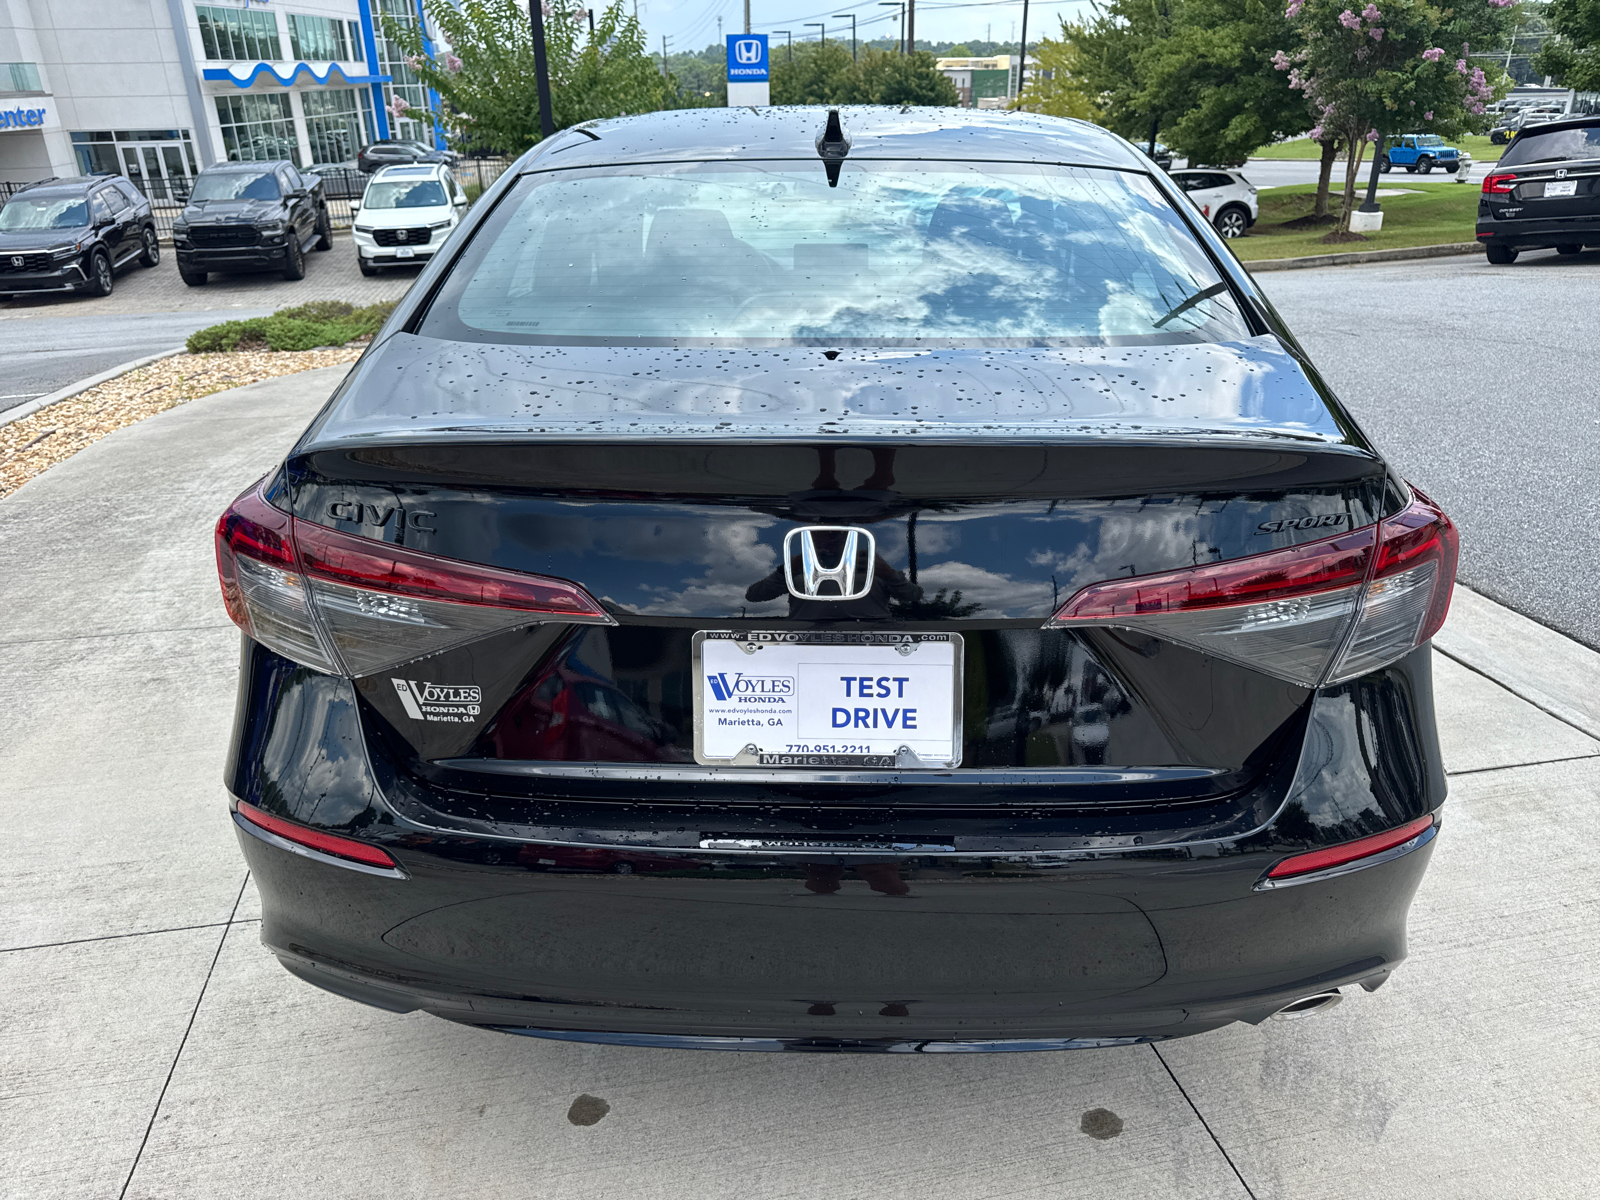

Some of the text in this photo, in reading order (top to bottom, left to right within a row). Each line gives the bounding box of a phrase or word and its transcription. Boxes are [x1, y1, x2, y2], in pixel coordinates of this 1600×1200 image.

[326, 501, 437, 534] CIVIC
[1254, 513, 1352, 535] SPORT
[396, 680, 479, 705] ED VOYLES
[718, 673, 791, 698] VOYLES
[840, 676, 909, 698] TEST
[421, 705, 467, 714] HONDA
[708, 707, 792, 715] www.edvoyleshonda.com
[426, 714, 475, 723] Marietta, GA
[718, 717, 783, 727] Marietta, GA
[832, 707, 917, 729] DRIVE
[785, 744, 871, 754] 770-951-2211
[863, 755, 893, 766] GA
